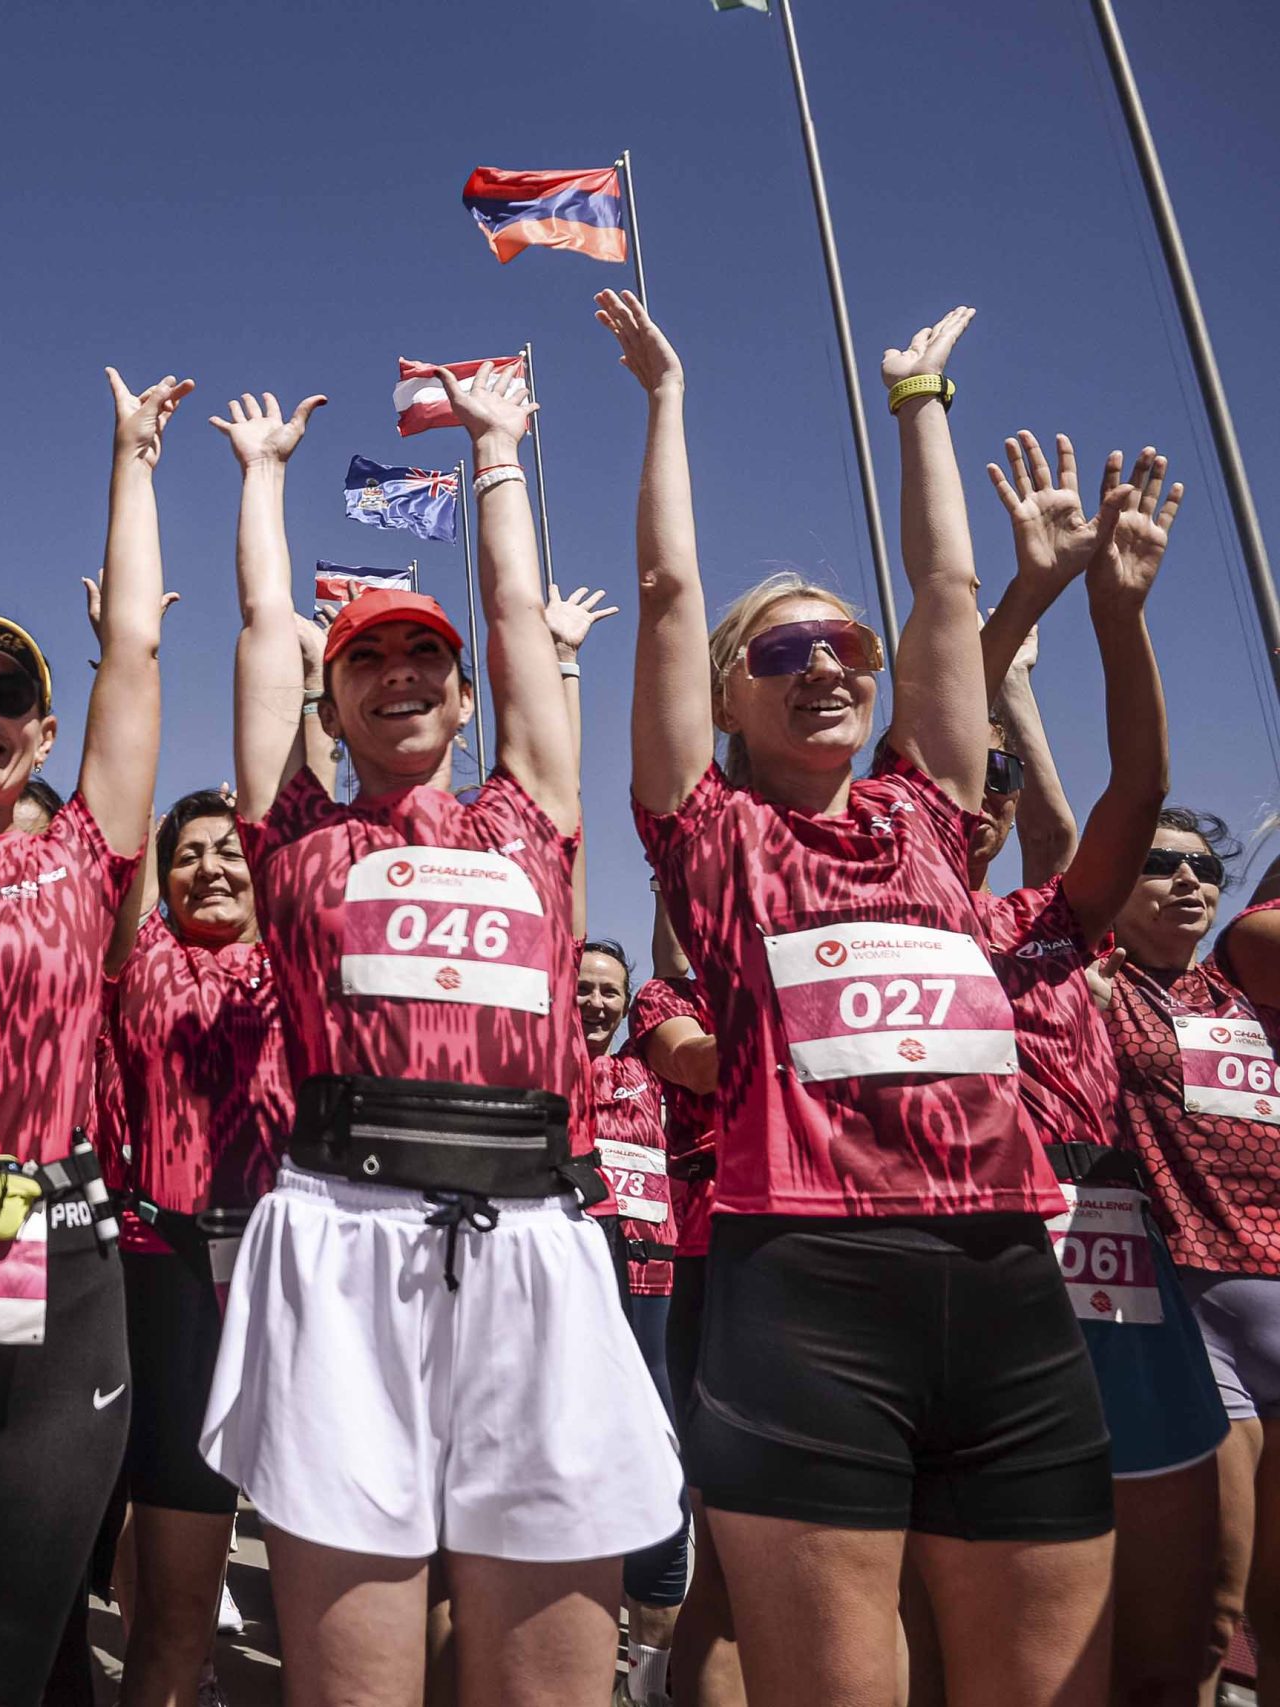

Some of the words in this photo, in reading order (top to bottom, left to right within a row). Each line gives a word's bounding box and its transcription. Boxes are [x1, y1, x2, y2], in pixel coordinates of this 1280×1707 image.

[420, 864, 508, 882] CHALLENGE
[386, 904, 511, 959] 046
[850, 939, 943, 951] CHALLENGE
[853, 950, 901, 960] WOMEN
[839, 978, 956, 1030] 027
[51, 1200, 92, 1229] PRO
[1053, 1236, 1134, 1282] 061
